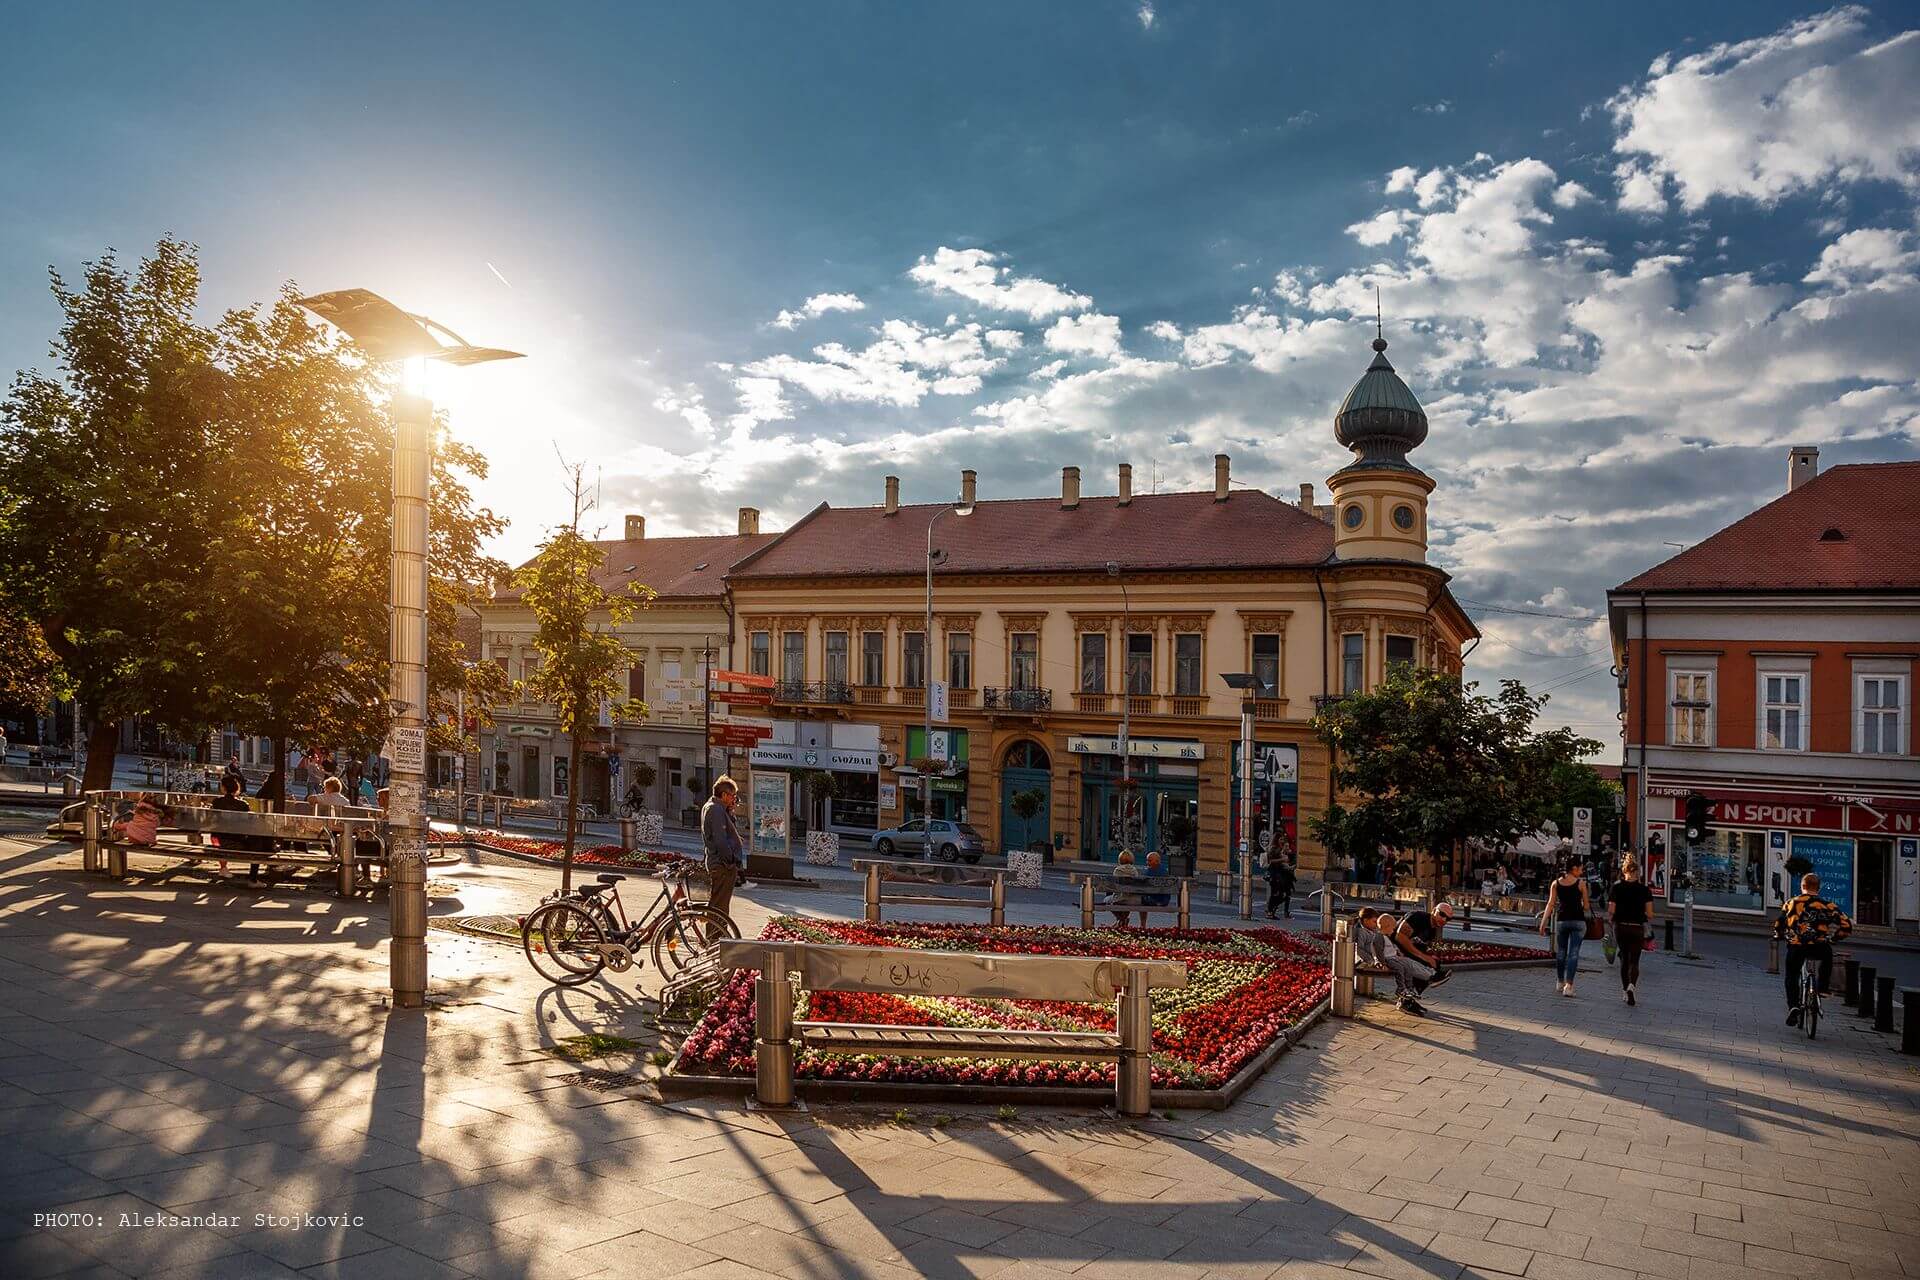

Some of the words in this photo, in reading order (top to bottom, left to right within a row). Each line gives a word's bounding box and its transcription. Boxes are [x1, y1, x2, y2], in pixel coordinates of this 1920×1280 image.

[752, 751, 793, 760] CROSSBOX
[1724, 803, 1739, 820] N
[1745, 805, 1816, 825] SPORT
[1820, 848, 1848, 858] PATIKE
